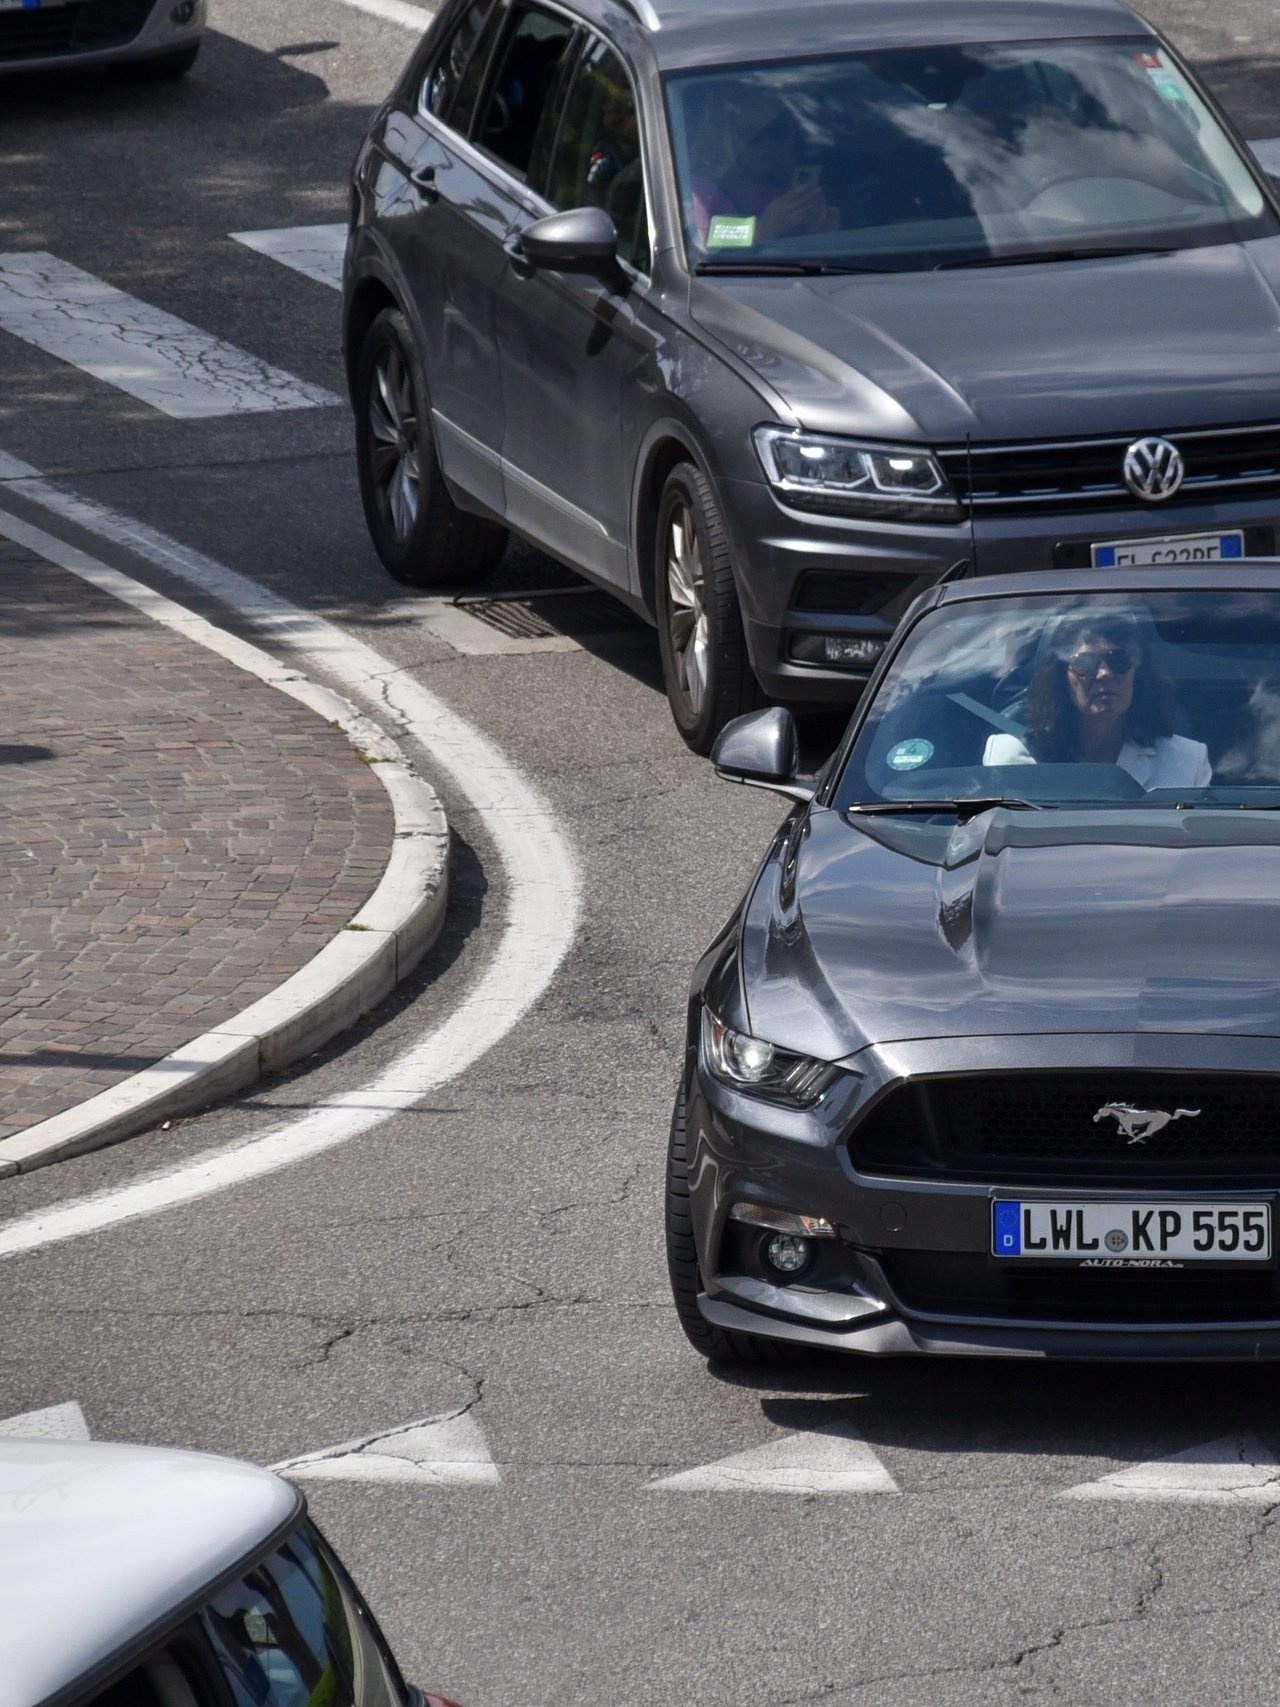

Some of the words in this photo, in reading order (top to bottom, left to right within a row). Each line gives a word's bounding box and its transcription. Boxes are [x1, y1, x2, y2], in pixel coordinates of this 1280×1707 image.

[1125, 438, 1183, 500] VW
[1003, 1234, 1013, 1246] D
[1023, 1208, 1099, 1250] LWL
[1132, 1210, 1181, 1251] KP
[1192, 1211, 1264, 1251] 555
